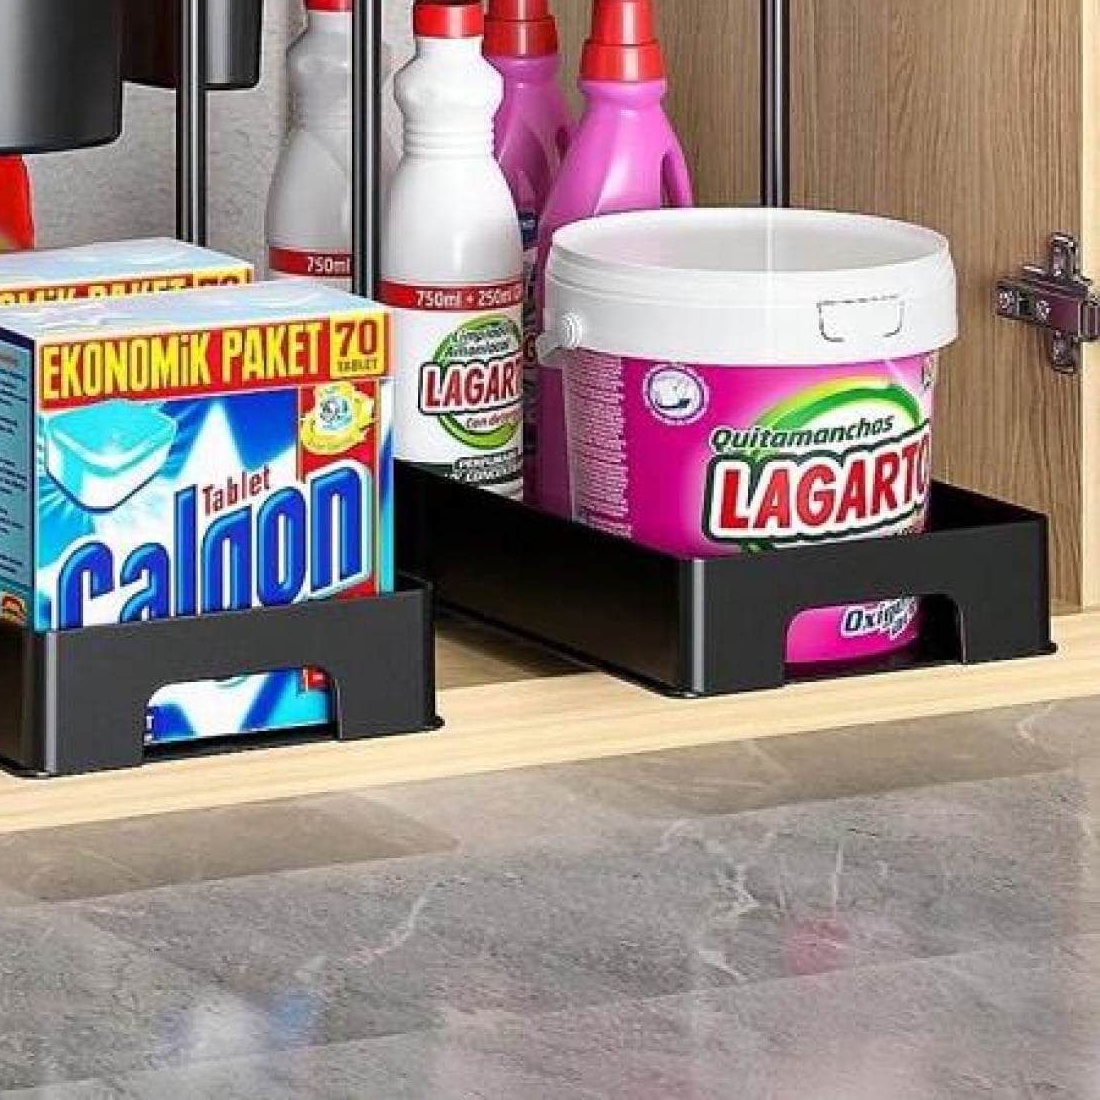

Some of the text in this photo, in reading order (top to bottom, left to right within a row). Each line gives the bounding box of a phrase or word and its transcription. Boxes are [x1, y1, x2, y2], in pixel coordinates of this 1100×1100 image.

[306, 256, 351, 274] 750ml
[416, 289, 463, 308] 750ml
[221, 321, 324, 384] PAKET
[335, 318, 377, 360] 70
[712, 414, 895, 451] Quitamanchas
[202, 465, 271, 515] Tablet
